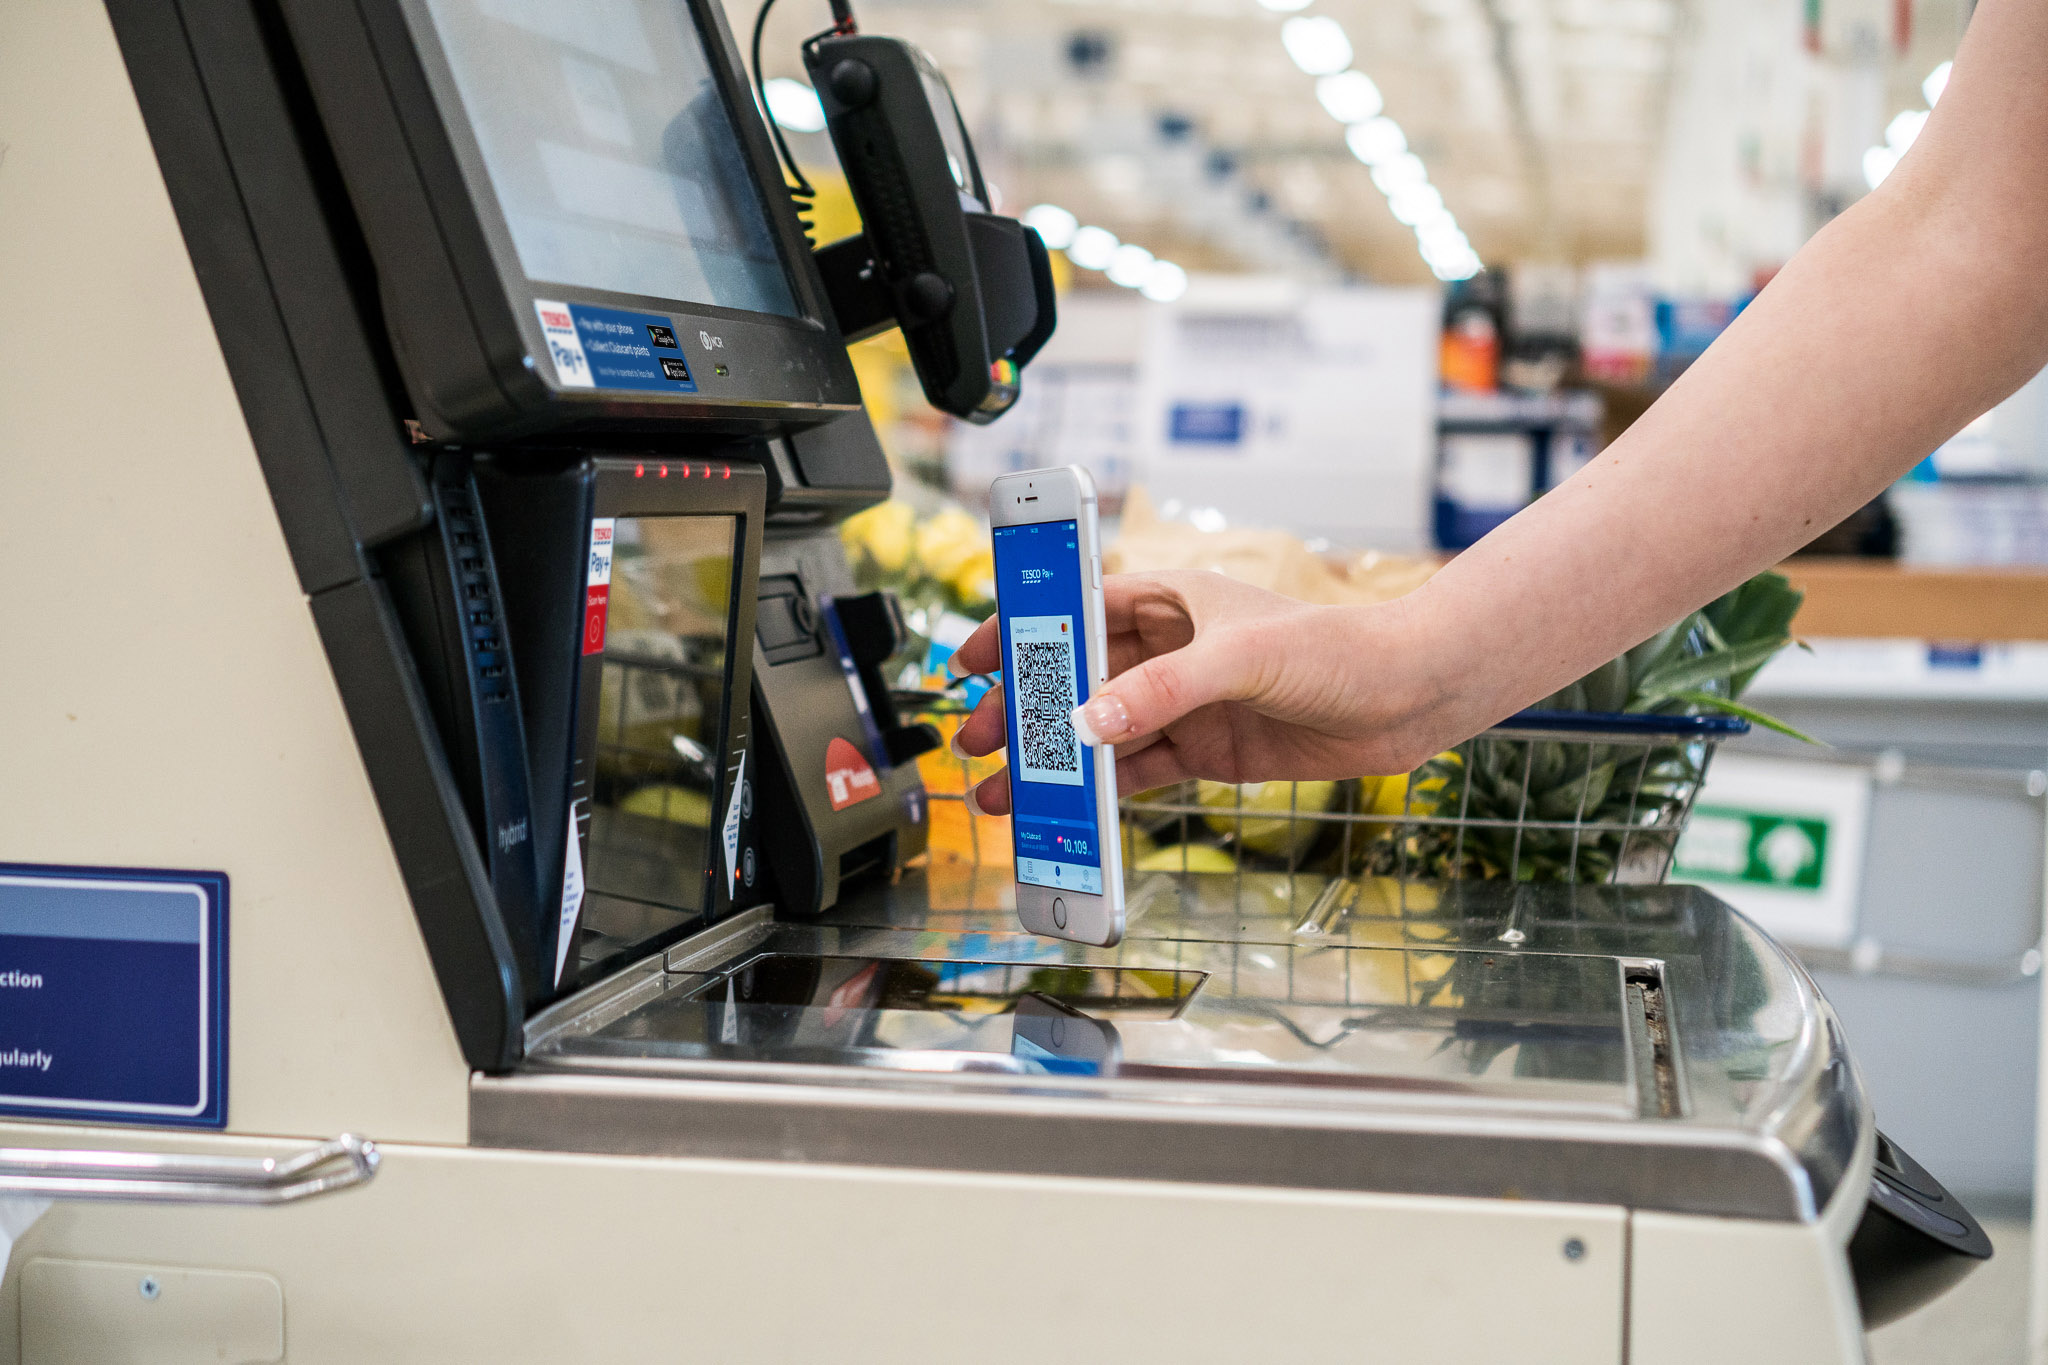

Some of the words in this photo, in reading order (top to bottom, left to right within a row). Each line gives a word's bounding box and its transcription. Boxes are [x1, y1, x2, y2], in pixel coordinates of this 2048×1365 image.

[541, 311, 571, 329] TESCO
[617, 321, 634, 336] phone
[711, 336, 725, 348] NCR
[551, 340, 582, 374] Pay+
[633, 345, 650, 358] points
[593, 527, 612, 541] TESCO
[590, 553, 609, 577] Pay+
[1021, 569, 1041, 580] TESCO
[1042, 569, 1054, 580] Pay+
[588, 595, 598, 606] Scan
[598, 595, 607, 605] here
[499, 816, 527, 853] hybrid
[1063, 839, 1087, 855] 10,109
[0, 969, 43, 988] ction
[0, 1047, 52, 1071] ularly
